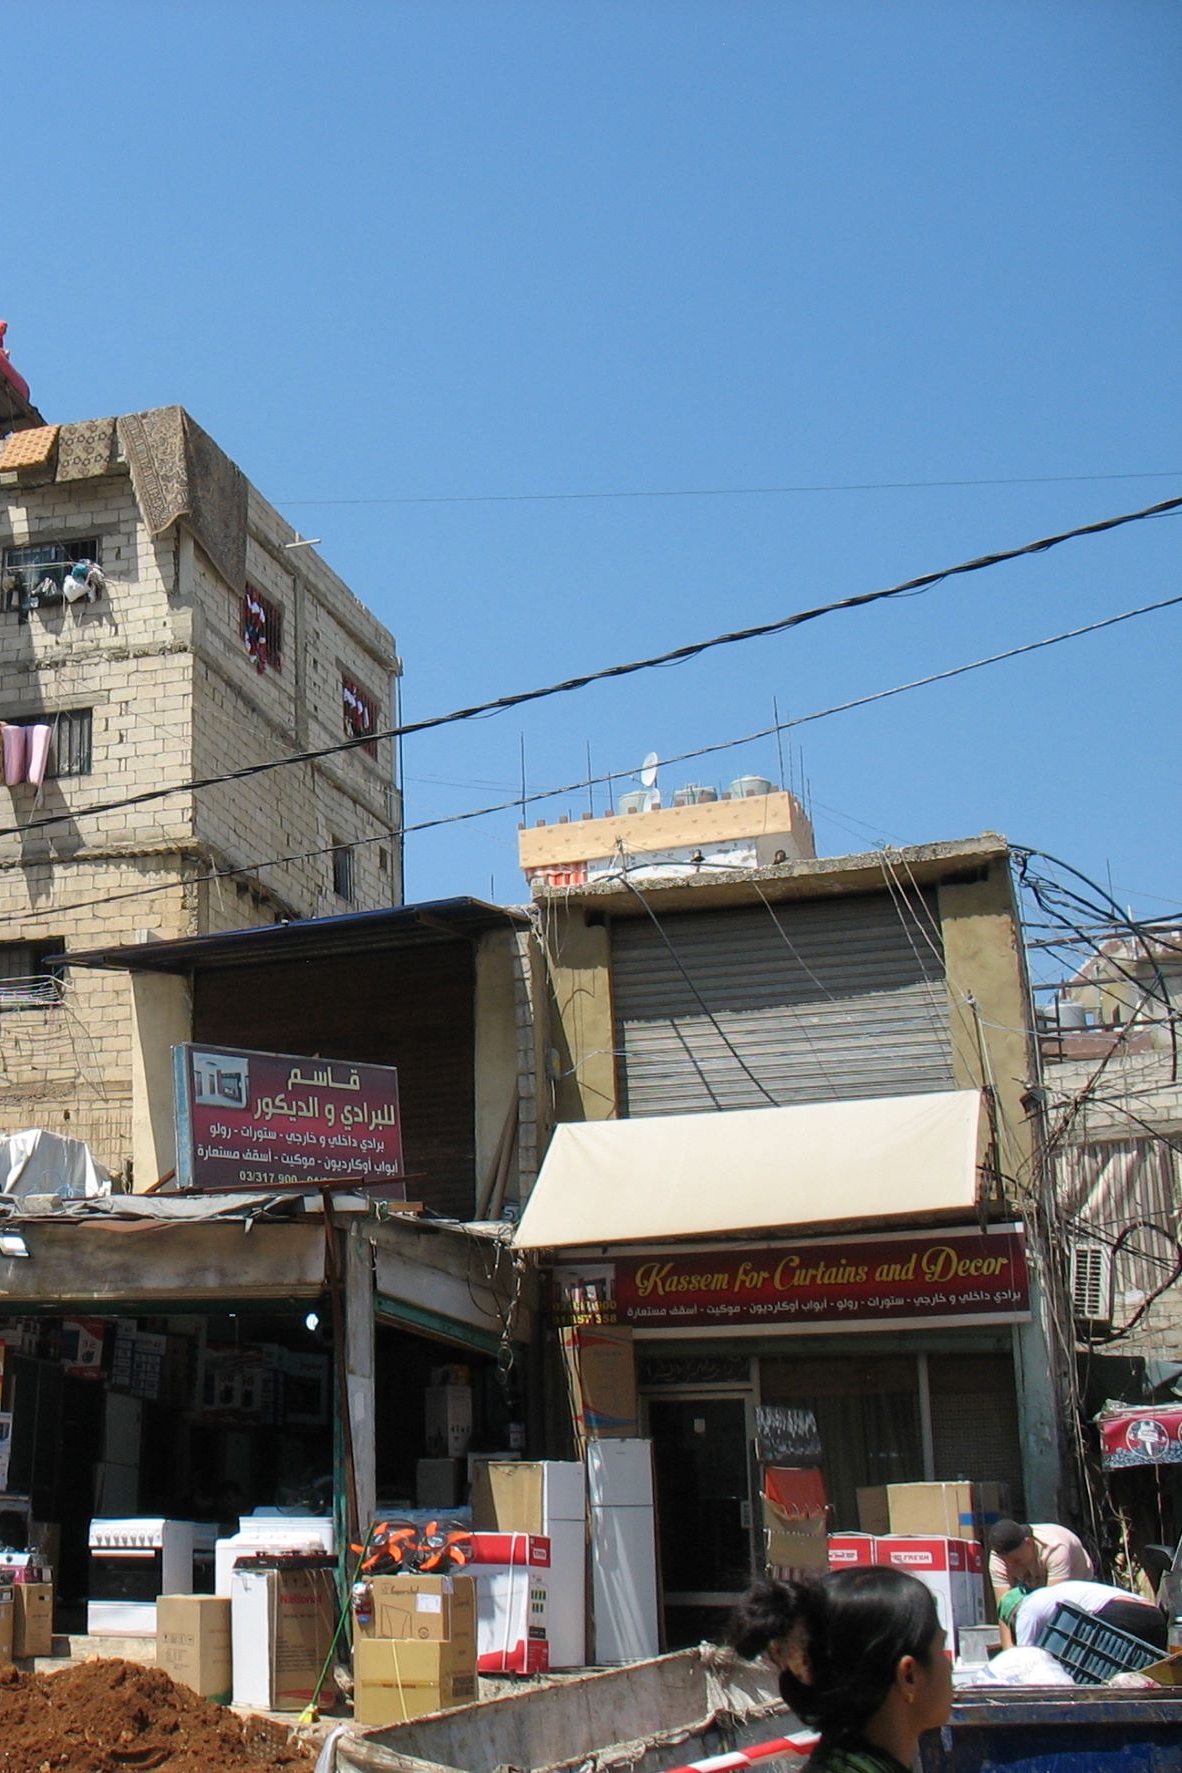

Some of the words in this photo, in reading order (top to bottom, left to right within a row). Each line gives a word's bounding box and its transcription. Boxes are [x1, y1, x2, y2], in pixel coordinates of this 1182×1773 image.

[287, 1066, 361, 1091] قاسم
[254, 1093, 319, 1122] الديكور
[324, 1104, 335, 1126] و
[340, 1101, 396, 1131] للبرادي
[209, 1122, 232, 1139] رولو
[241, 1125, 277, 1142] ستورات
[285, 1131, 317, 1146] خارجي
[319, 1135, 326, 1148] و
[328, 1134, 358, 1148] داخلي
[360, 1137, 385, 1153] برادي
[197, 1144, 240, 1160] مستعارة
[281, 1153, 315, 1169] موكيت
[239, 1170, 275, 1183] 03/317
[635, 1262, 729, 1297] Kassem
[733, 1262, 770, 1293] for
[773, 1255, 868, 1291] Curtains
[874, 1253, 918, 1282] and
[921, 1246, 1009, 1282] Decor
[836, 1297, 858, 1311] رولو
[913, 1293, 946, 1307] خارجي
[958, 1290, 991, 1304] داخلي
